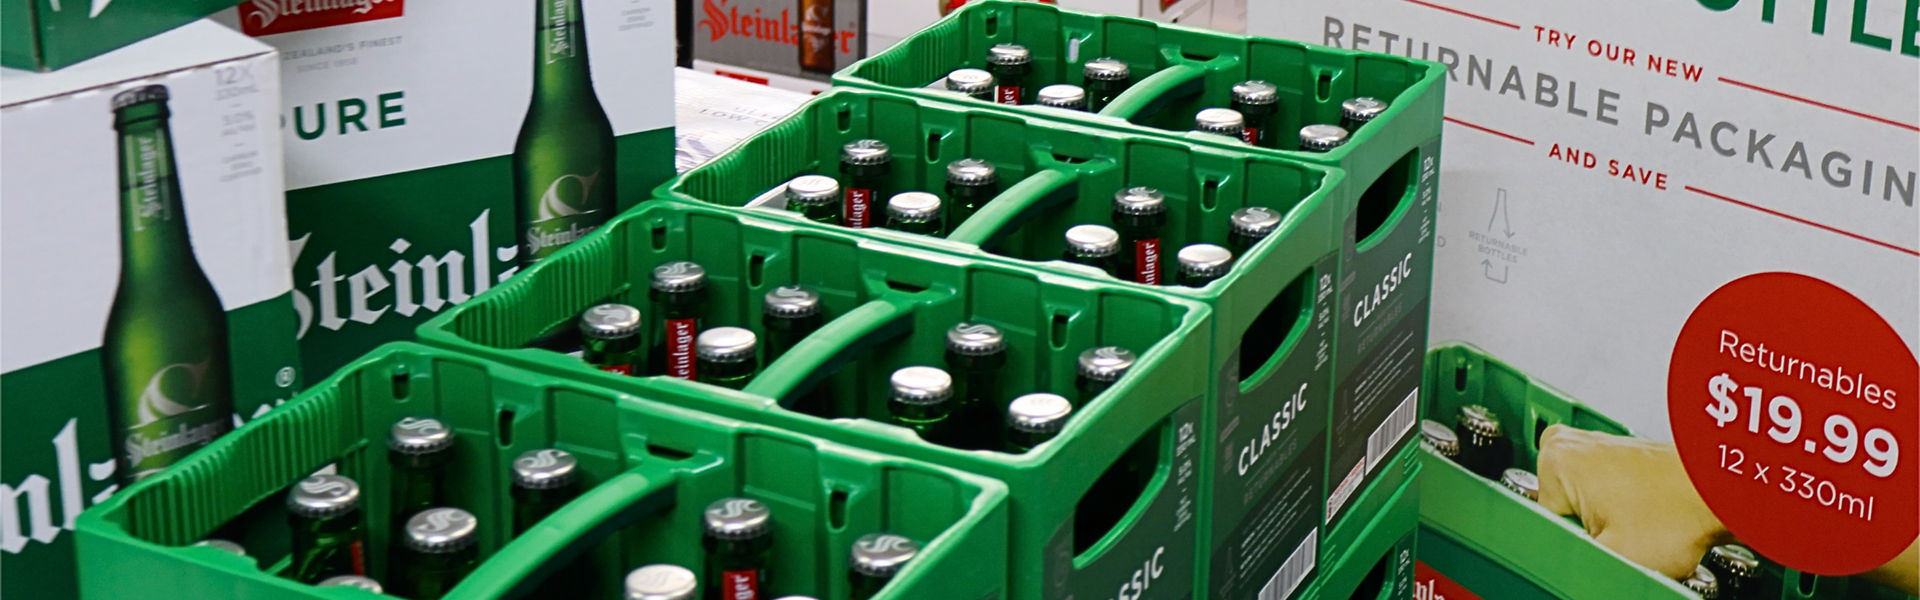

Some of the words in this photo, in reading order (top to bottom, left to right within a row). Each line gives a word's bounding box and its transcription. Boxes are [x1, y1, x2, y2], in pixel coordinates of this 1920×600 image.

[1534, 25, 1576, 50] TRY
[1587, 39, 1636, 66] OUR
[1648, 54, 1703, 83] NEW
[281, 91, 406, 141] URE
[1323, 15, 1620, 126] RETURNABLE
[1645, 101, 1917, 207] PACKAGIN
[1549, 143, 1597, 169] AND
[1608, 159, 1668, 190] SAVE
[1353, 252, 1412, 328] CLASSIC
[1719, 329, 1897, 410] Returnables
[1238, 382, 1307, 476] CLASSIC
[1704, 372, 1900, 478] $19.99
[1718, 444, 1745, 475] 12
[1754, 462, 1769, 484] x
[1779, 465, 1874, 521] 330ml
